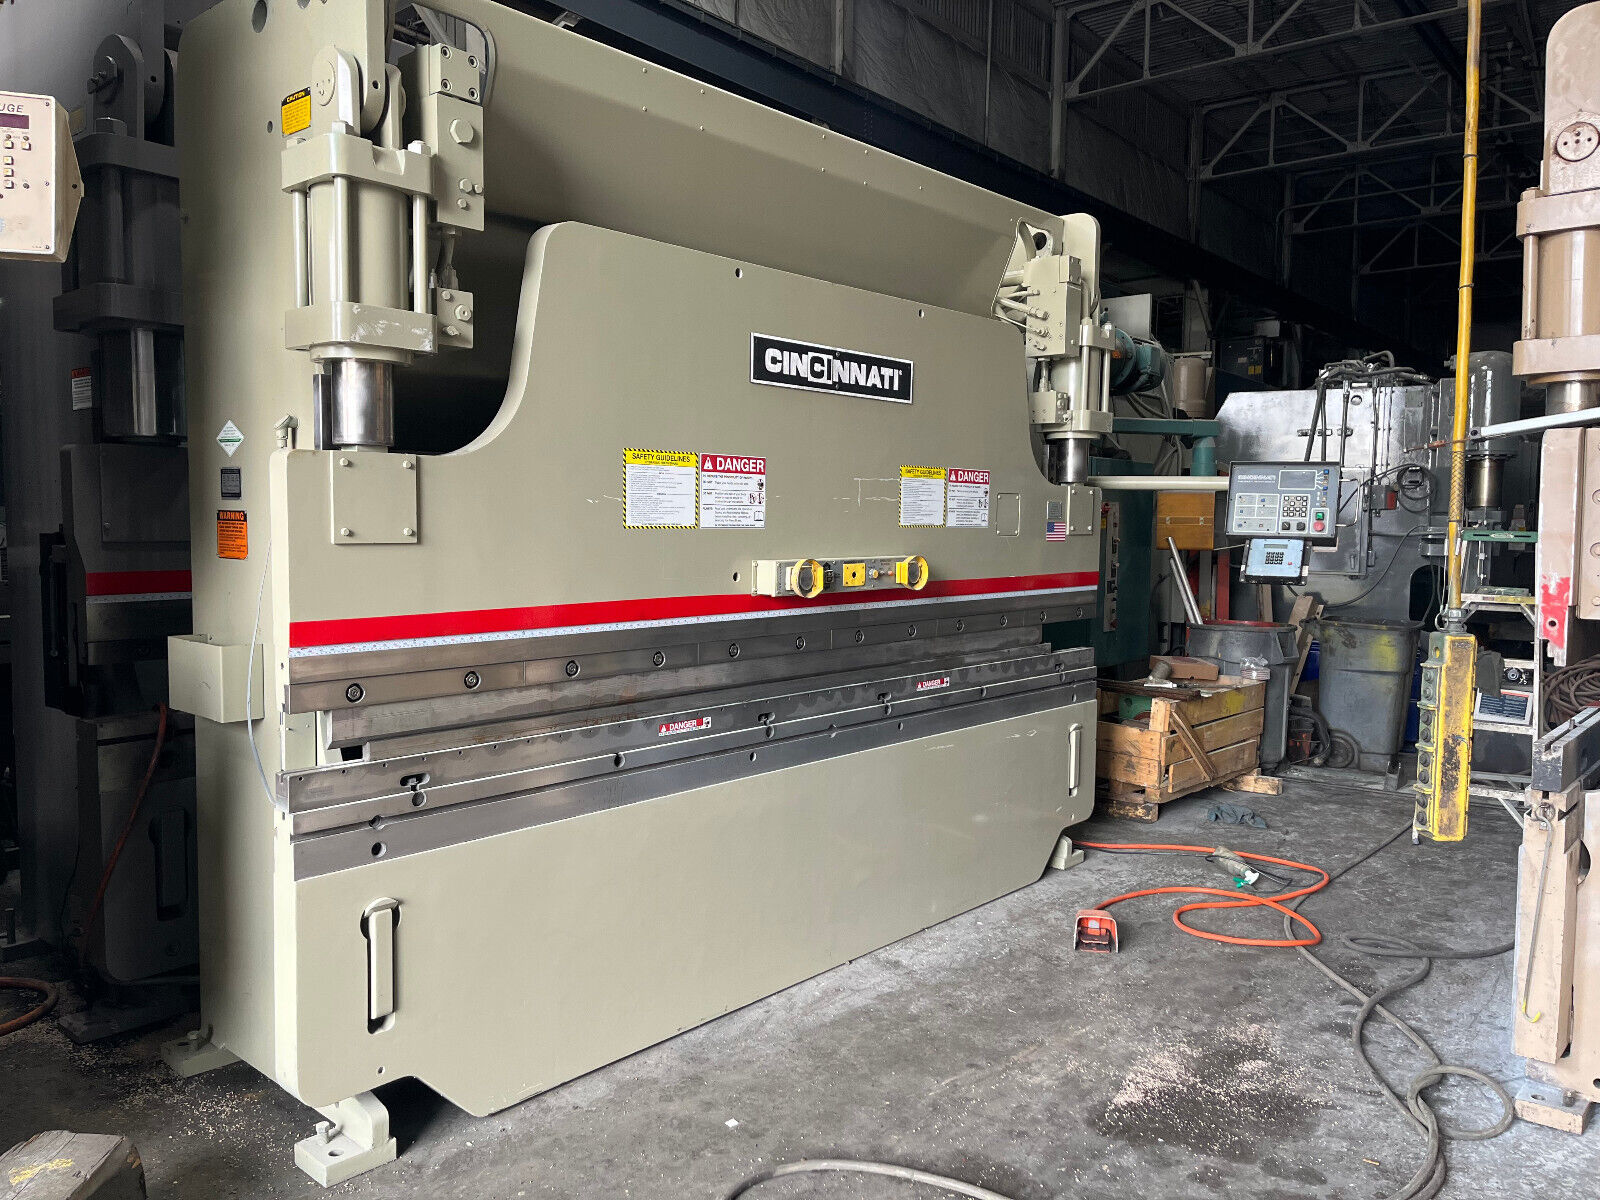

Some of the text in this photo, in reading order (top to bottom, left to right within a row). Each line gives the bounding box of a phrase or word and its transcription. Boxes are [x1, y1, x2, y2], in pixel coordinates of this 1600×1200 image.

[764, 347, 900, 391] CINCINNATI
[632, 452, 691, 463] SAFETY GUIDELINES
[716, 457, 765, 473] DANGER
[957, 470, 989, 483] DANGER
[669, 719, 697, 731] DANGER
